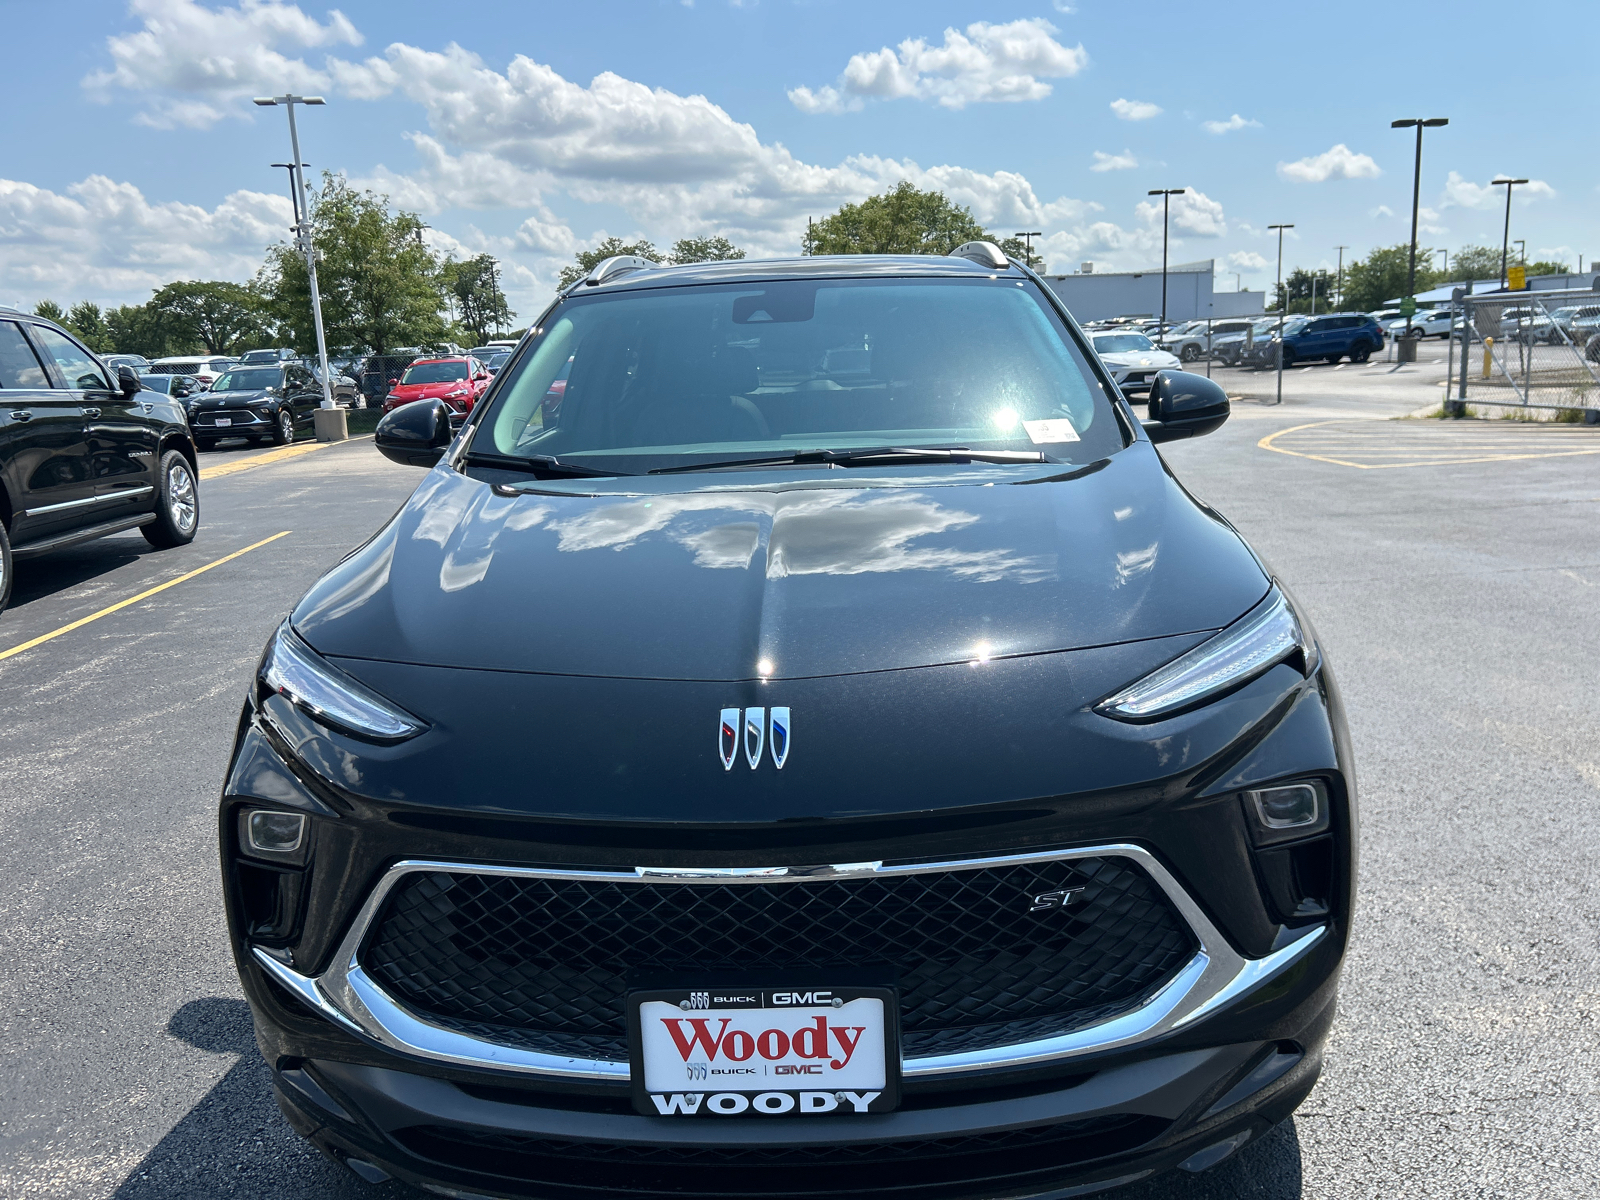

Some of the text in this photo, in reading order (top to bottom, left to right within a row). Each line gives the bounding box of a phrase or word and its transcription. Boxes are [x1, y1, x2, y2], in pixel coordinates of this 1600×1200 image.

[1029, 886, 1086, 912] ST
[772, 991, 832, 1005] GMC
[660, 1015, 867, 1070] Woody
[775, 1064, 823, 1075] GMC
[650, 1091, 882, 1115] WOODY
